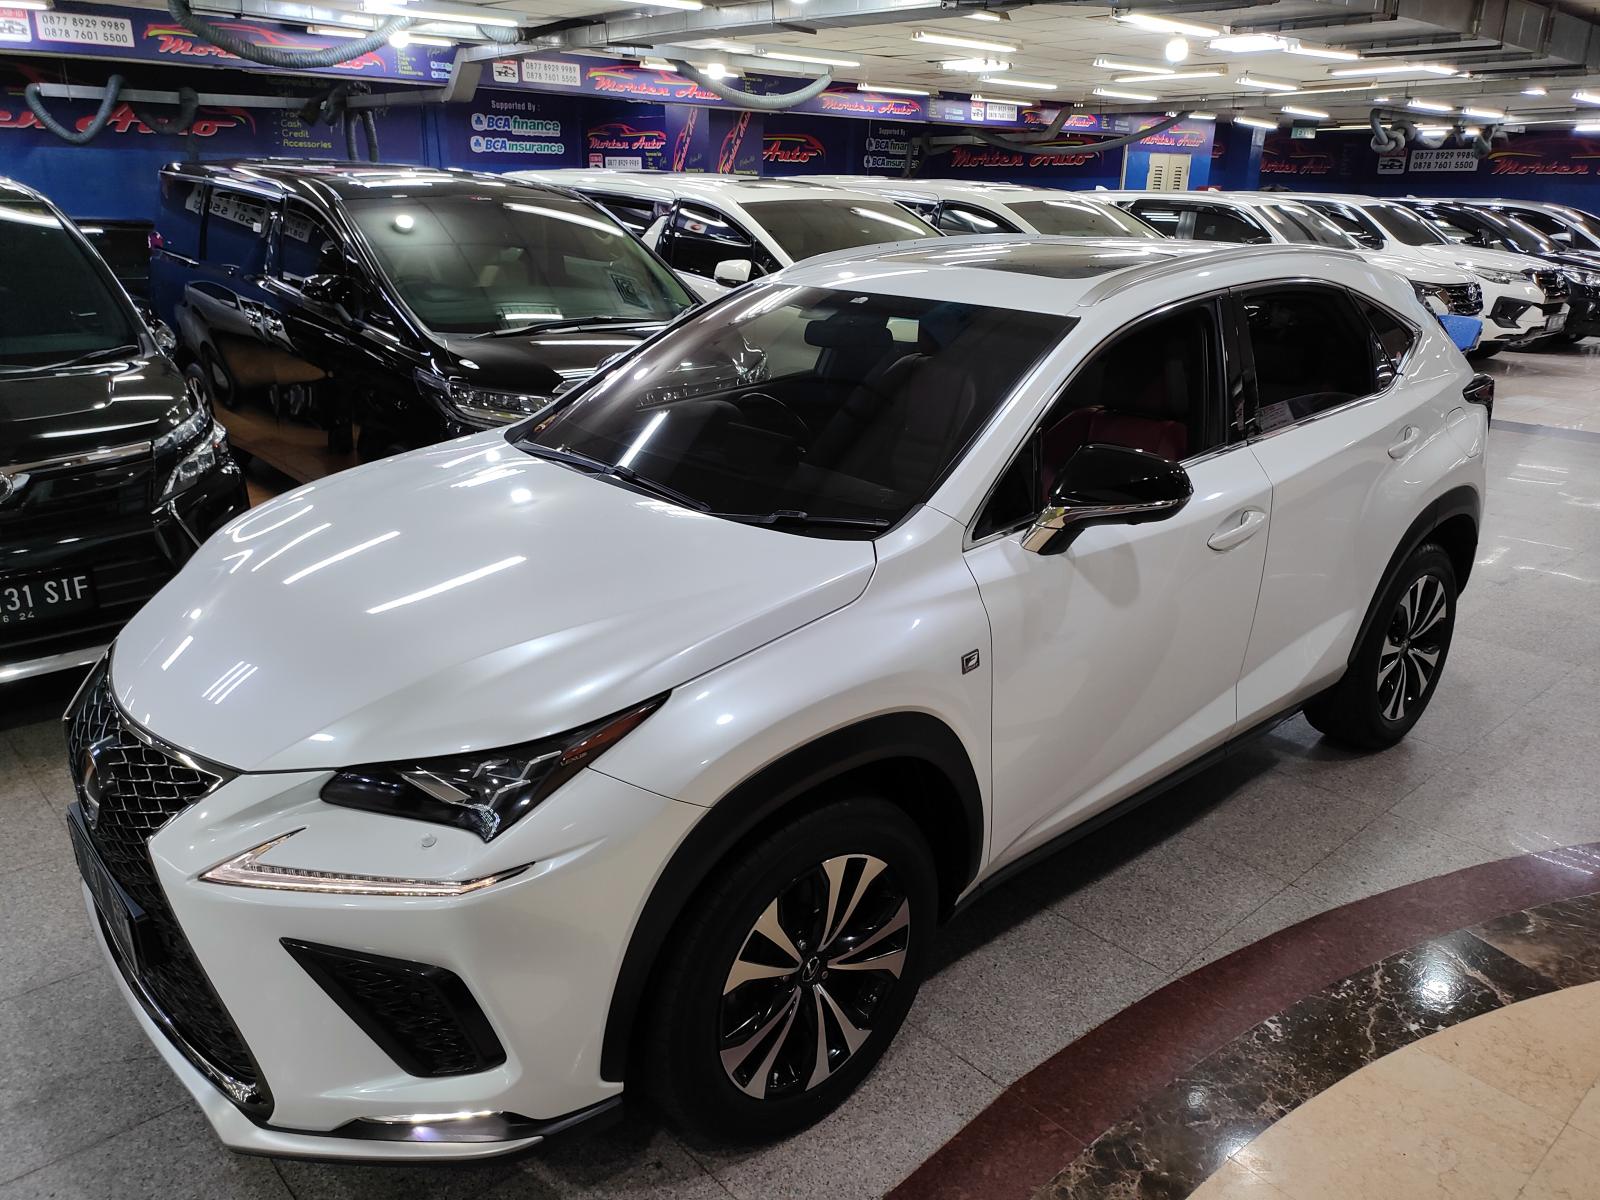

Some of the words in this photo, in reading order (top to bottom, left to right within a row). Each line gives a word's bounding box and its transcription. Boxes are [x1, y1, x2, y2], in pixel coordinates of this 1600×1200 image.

[42, 14, 68, 25] 0877
[72, 17, 97, 28] 8929
[100, 19, 126, 30] 9989
[44, 28, 70, 38] 0878
[74, 30, 98, 40] 7601
[103, 32, 128, 44] 5500
[525, 62, 542, 70] 0877
[544, 63, 560, 72] 8929
[560, 64, 576, 73] 9989
[526, 71, 542, 80] 0878
[594, 76, 670, 96] Morten
[491, 100, 526, 111] Supported
[528, 102, 536, 112] By
[822, 98, 874, 112] Morten
[878, 100, 916, 115] Auto
[280, 120, 302, 128] Cash
[282, 128, 310, 138] Credit
[283, 139, 332, 149] Accessories
[589, 136, 630, 150] Morten
[632, 136, 666, 150] Auto
[1177, 134, 1204, 147] Auto
[763, 140, 817, 162] Auto
[951, 146, 1024, 168] Morten
[1413, 162, 1431, 170] 0878
[1454, 161, 1474, 169] 5500
[1491, 160, 1589, 174] Morten
[0, 585, 34, 614] 31
[44, 576, 88, 604] SIF
[20, 611, 35, 620] 24
